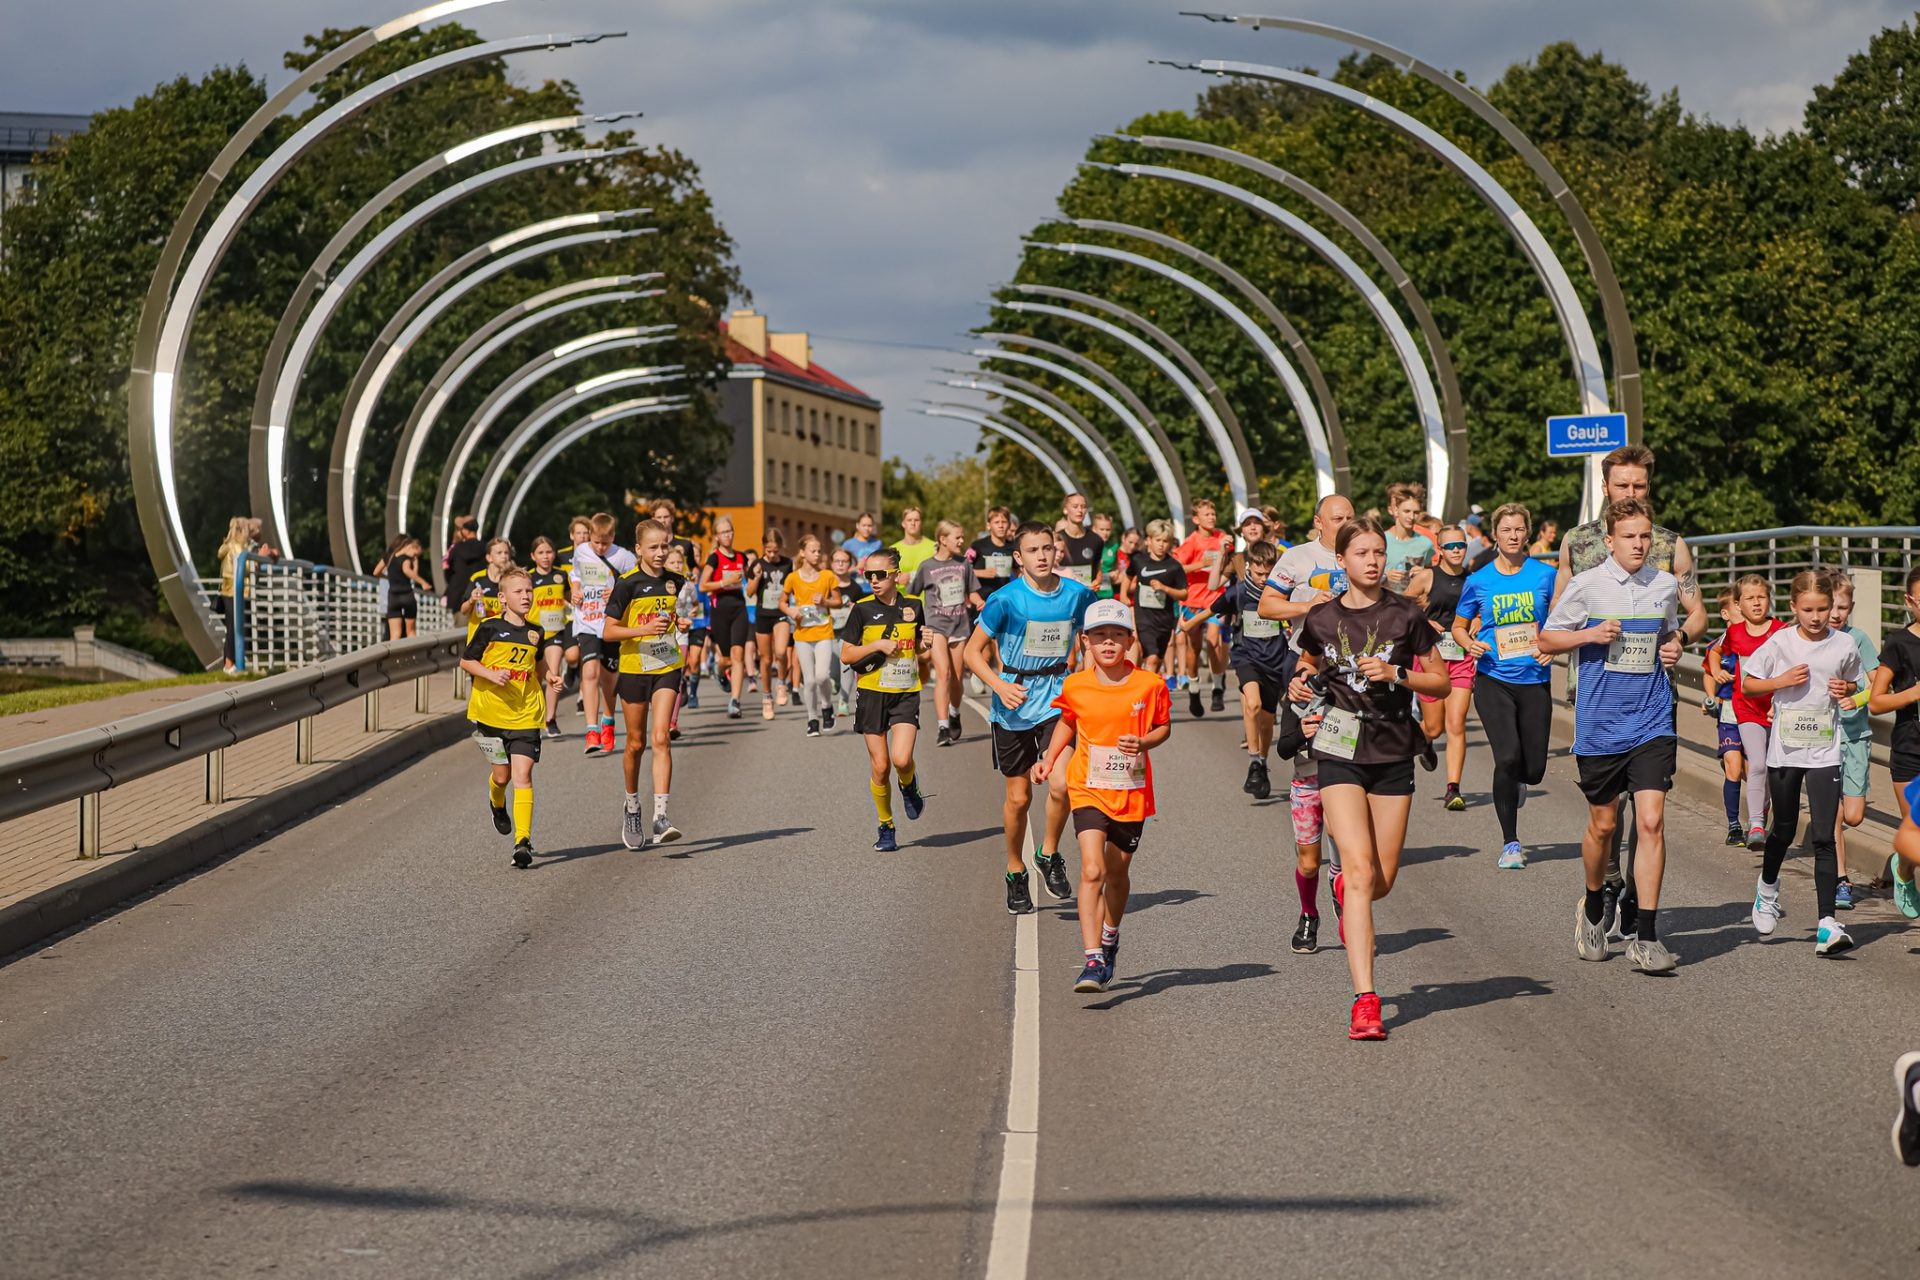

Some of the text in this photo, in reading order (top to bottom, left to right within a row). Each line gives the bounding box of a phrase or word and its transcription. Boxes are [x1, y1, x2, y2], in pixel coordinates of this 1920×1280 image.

[1567, 423, 1609, 444] Gauja
[547, 587, 553, 596] 8
[655, 598, 668, 611] 35
[1041, 634, 1061, 642] 2164
[1508, 635, 1528, 644] 4830
[509, 646, 528, 664] 27
[1621, 646, 1648, 655] 10774
[1794, 723, 1819, 731] 2666
[1105, 762, 1131, 771] 2297
